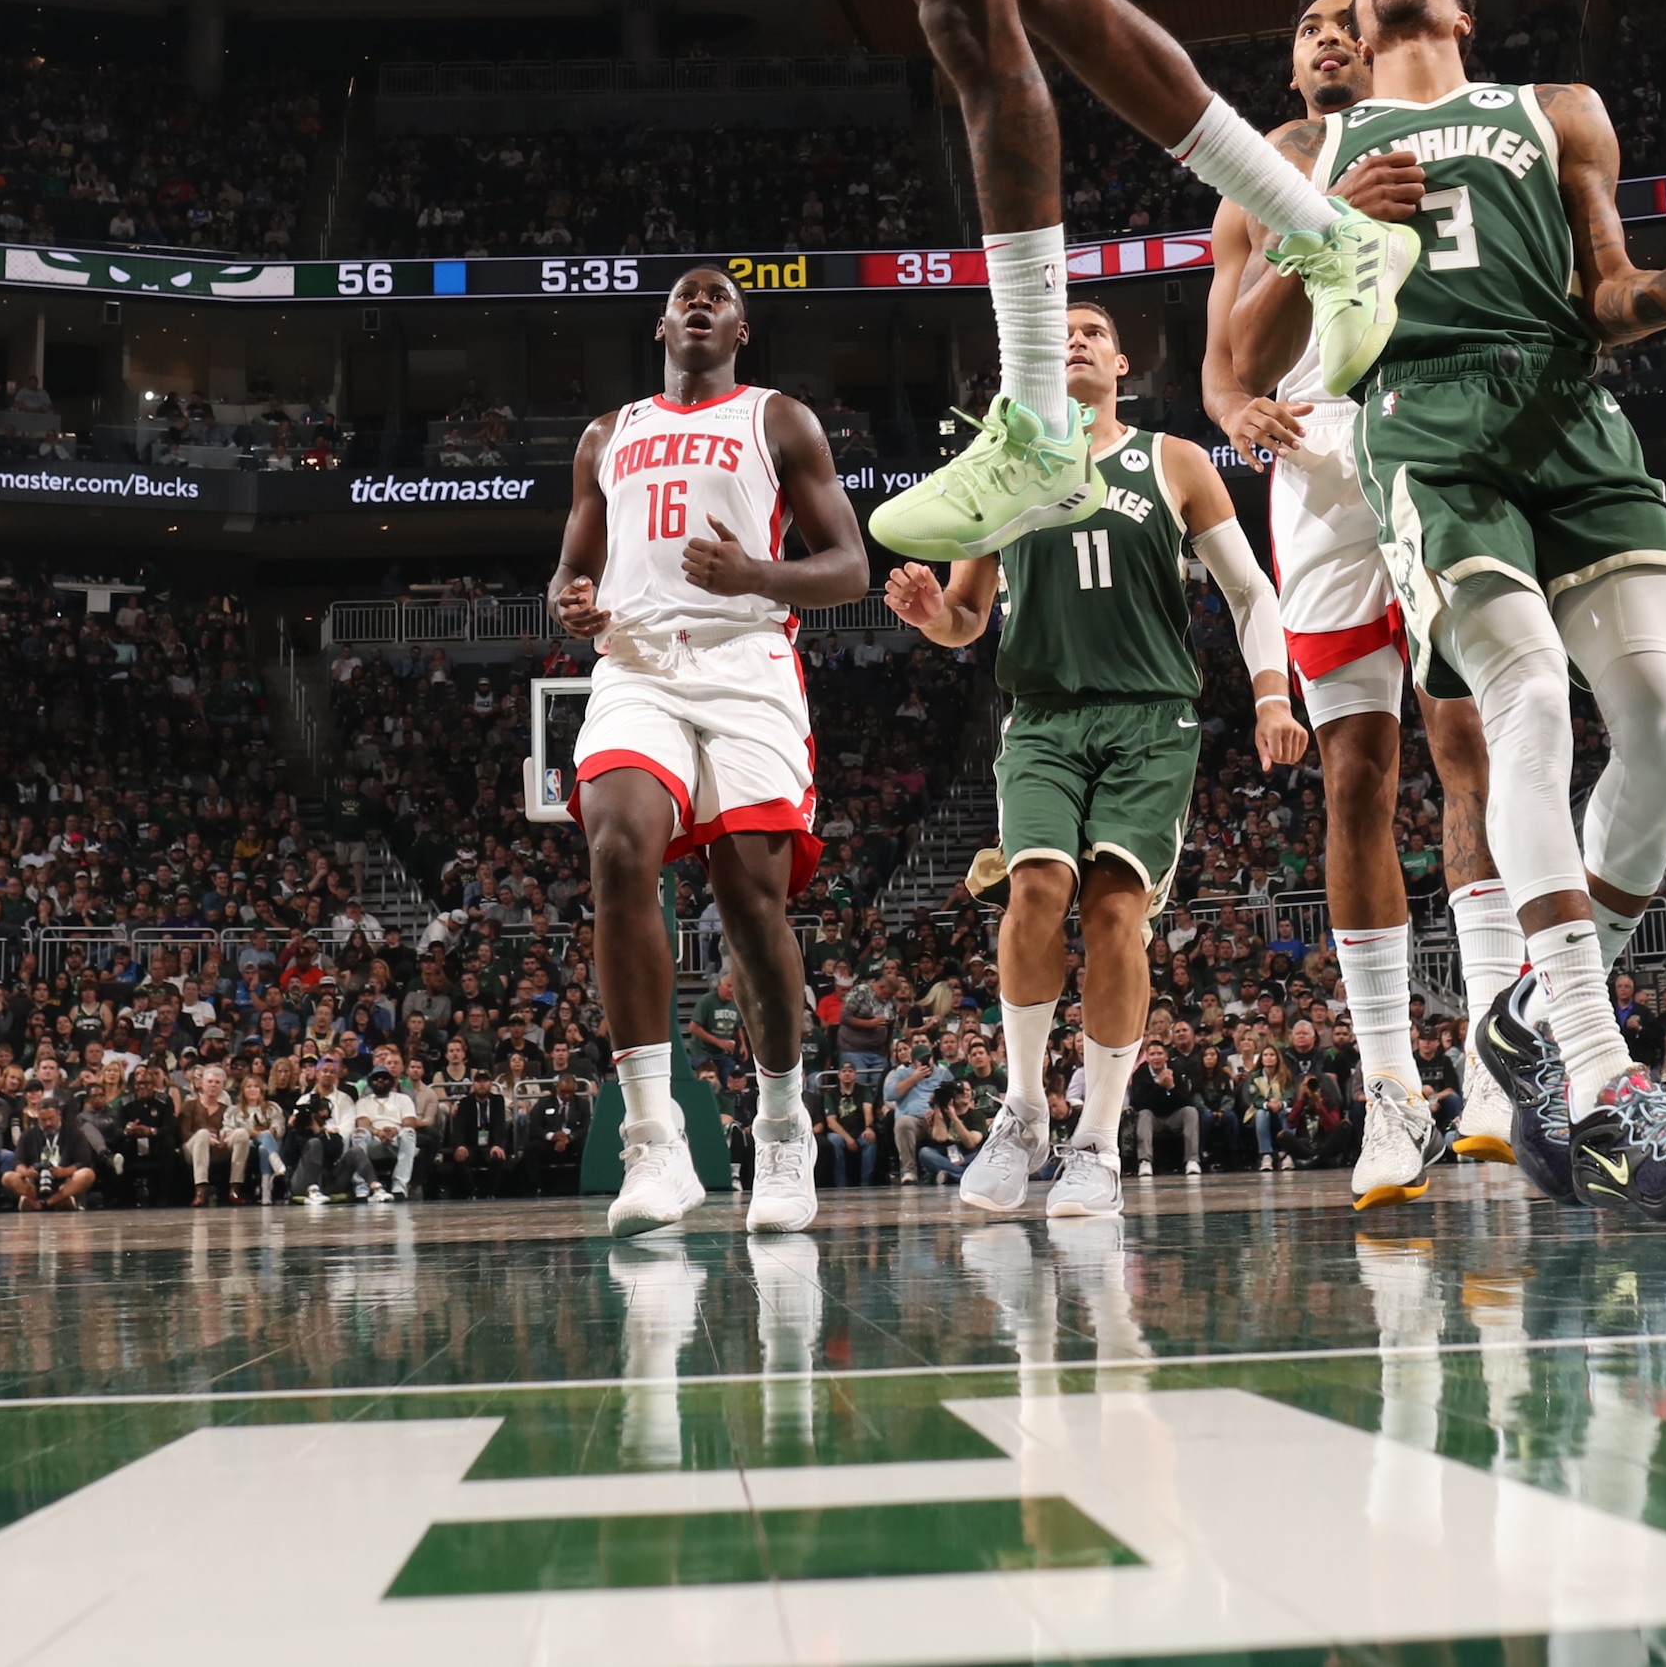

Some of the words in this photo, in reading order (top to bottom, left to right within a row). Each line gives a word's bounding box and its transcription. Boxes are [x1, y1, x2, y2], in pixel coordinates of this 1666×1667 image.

[1421, 185, 1481, 271] 3
[337, 263, 393, 295] 56
[541, 260, 639, 294] 5:35
[728, 256, 807, 290] 2nd
[896, 252, 953, 286] 35
[349, 474, 535, 504] ticketmaster
[612, 433, 743, 488] ROCKETS
[647, 480, 688, 542] 16
[1072, 529, 1112, 590] 11
